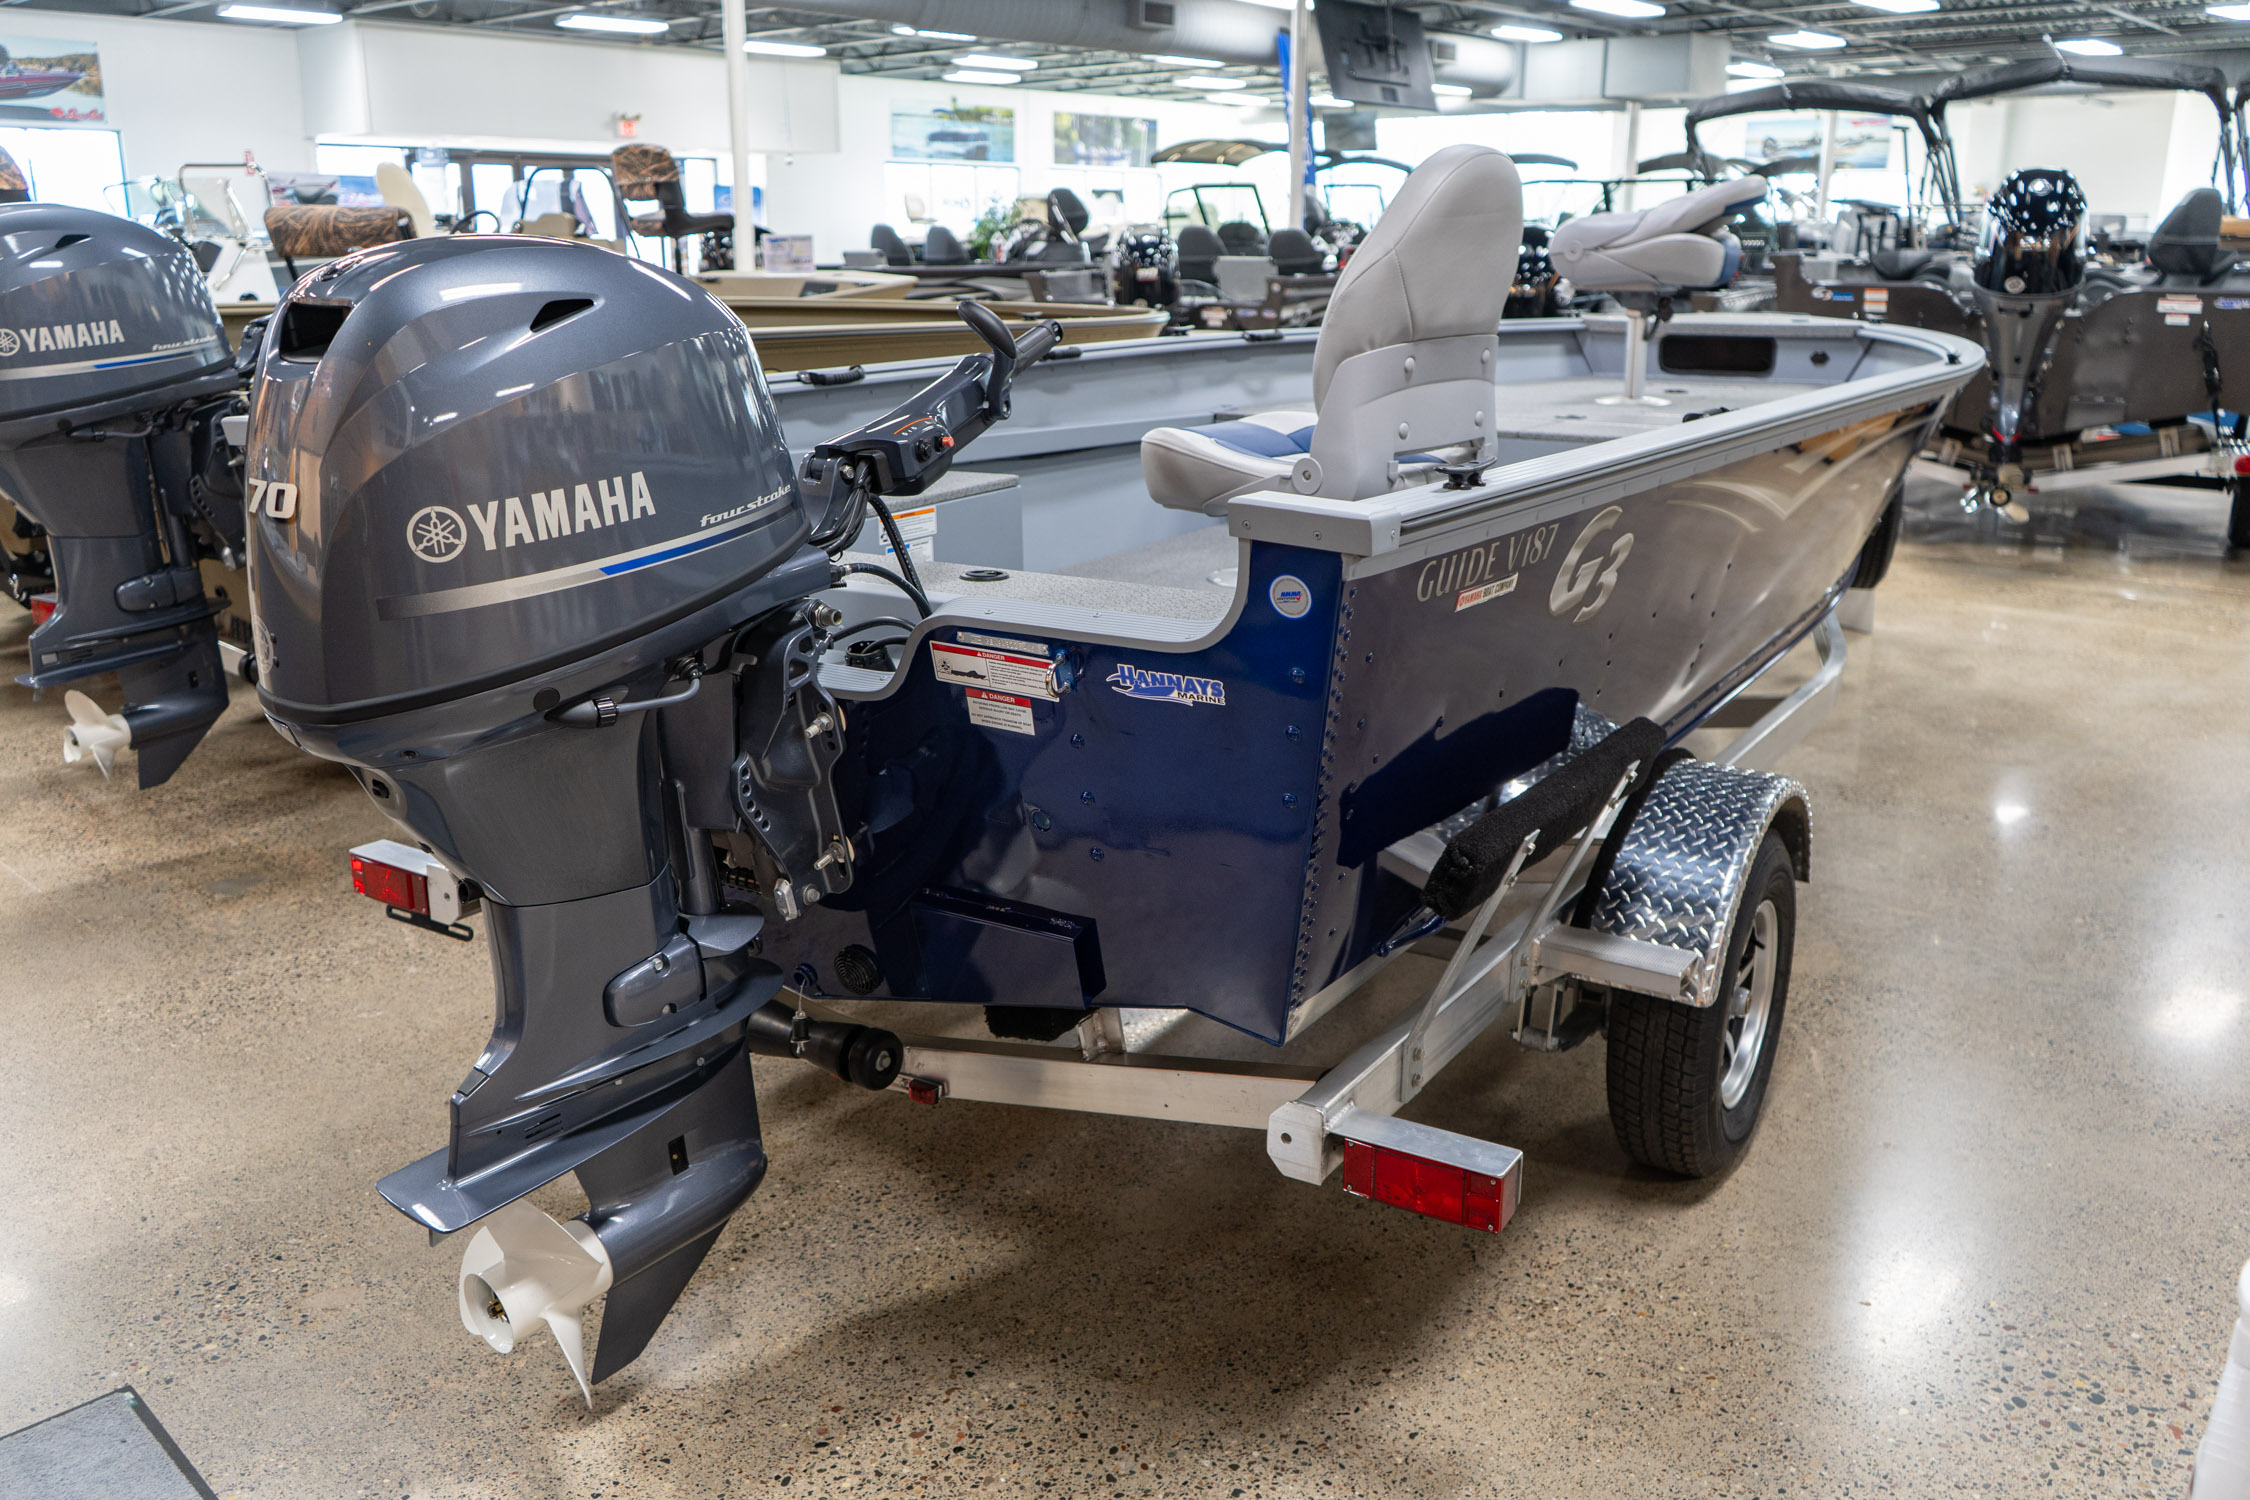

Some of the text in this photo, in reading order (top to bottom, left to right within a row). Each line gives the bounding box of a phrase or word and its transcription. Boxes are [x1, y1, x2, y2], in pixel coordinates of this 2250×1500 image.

[19, 319, 126, 353] YAMAHA
[248, 477, 298, 519] 70
[467, 471, 656, 551] YAMAHA
[1416, 523, 1560, 602] GUIDE V187
[1549, 505, 1635, 623] G3
[1482, 584, 1495, 599] BOAT
[1494, 579, 1515, 594] COMPANY
[989, 693, 1016, 703] DANGER
[1117, 664, 1224, 698] HANNAYS
[1177, 692, 1225, 704] MARINE
